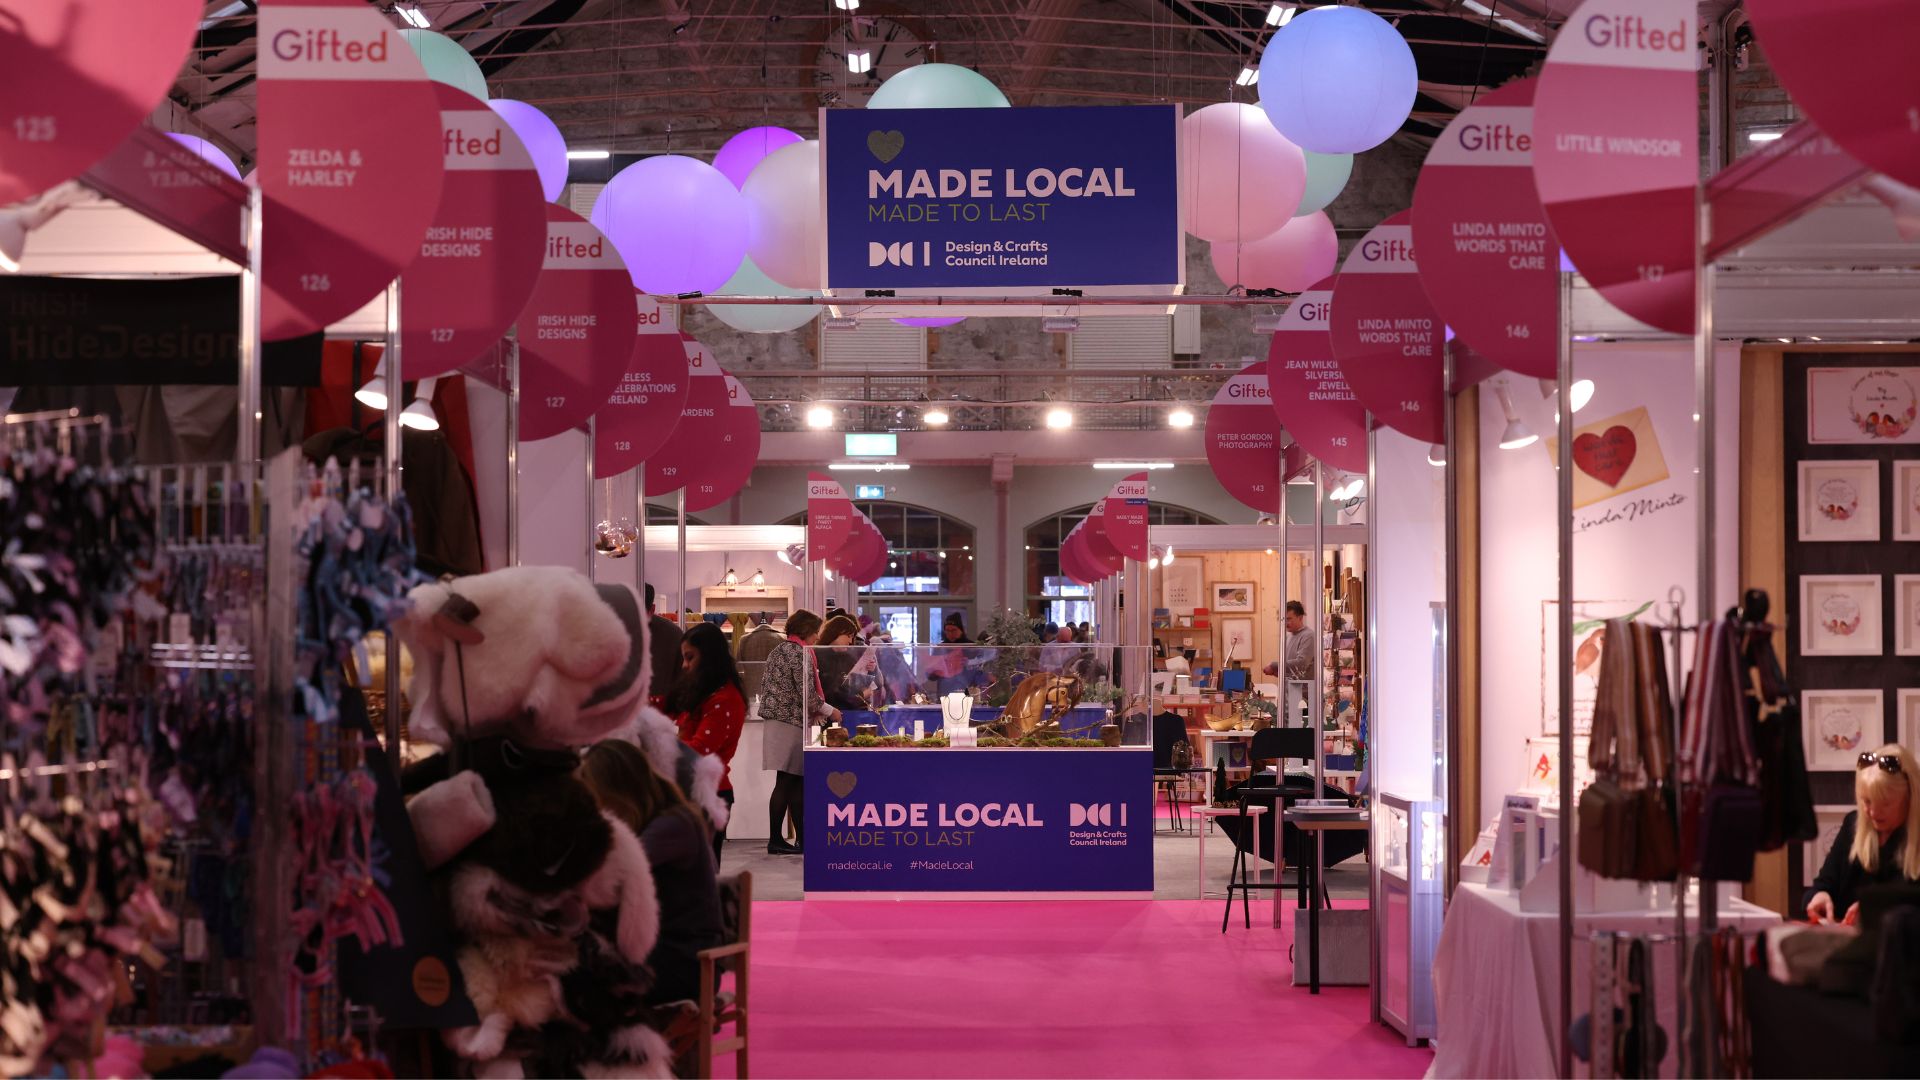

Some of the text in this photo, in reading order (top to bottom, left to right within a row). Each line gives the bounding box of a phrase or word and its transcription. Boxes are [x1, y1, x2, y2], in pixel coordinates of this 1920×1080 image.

[1585, 15, 1686, 52] Gifted
[272, 28, 388, 63] Gifted
[14, 118, 56, 141] 125
[444, 128, 500, 157] fted
[1459, 124, 1532, 152] Gifte
[1555, 133, 1682, 158] LITTLE WINDSOR
[287, 149, 363, 167] ZELDA &
[287, 169, 356, 187] HARLEY
[868, 167, 1135, 199] MADE LOCAL
[868, 203, 1051, 222] MADE TO LAST
[461, 227, 493, 241] HIDE
[1452, 223, 1546, 237] LINDA MINTO
[421, 243, 481, 257] DESIGNS
[549, 236, 603, 258] ifted
[945, 240, 1048, 255] Design & Crafts
[1361, 240, 1416, 262] Gifte
[1454, 239, 1546, 253] WORDS THAT
[945, 254, 1048, 267] Council Ireland
[1508, 256, 1546, 270] CARE
[300, 274, 330, 291] 126
[1299, 302, 1329, 322] Gif
[537, 315, 597, 326] IRISH HIDE
[1357, 319, 1432, 330] LINDA MINTO
[430, 330, 455, 342] 127
[537, 329, 587, 340] DESIGNS
[1359, 332, 1432, 343] WORDS THAT
[1505, 325, 1530, 338] 146
[1402, 345, 1432, 356] CARE
[1284, 360, 1309, 369] JEAN
[621, 373, 652, 382] ELESS
[614, 383, 677, 393] ELEBRATIONS
[1308, 391, 1357, 401] ENAMELLE
[545, 397, 566, 408] 127
[1400, 401, 1420, 412] 146
[681, 408, 715, 417] ARDENS
[1217, 433, 1273, 441] PETER GORDON
[1331, 437, 1348, 447] 145
[614, 441, 631, 451] 128
[1218, 442, 1273, 450] PHOTOGRAPHY
[662, 467, 677, 476] 129
[700, 485, 713, 493] 130
[811, 486, 838, 496] Gifted
[1117, 486, 1144, 496] Gifted
[827, 803, 1044, 827] MADE LOCAL
[827, 831, 975, 847] MADE TO LAST
[1069, 831, 1127, 840] Design & Crafts
[1069, 839, 1127, 847] Council Ireland
[827, 860, 975, 871] madelocal.ie #MadeLocal
